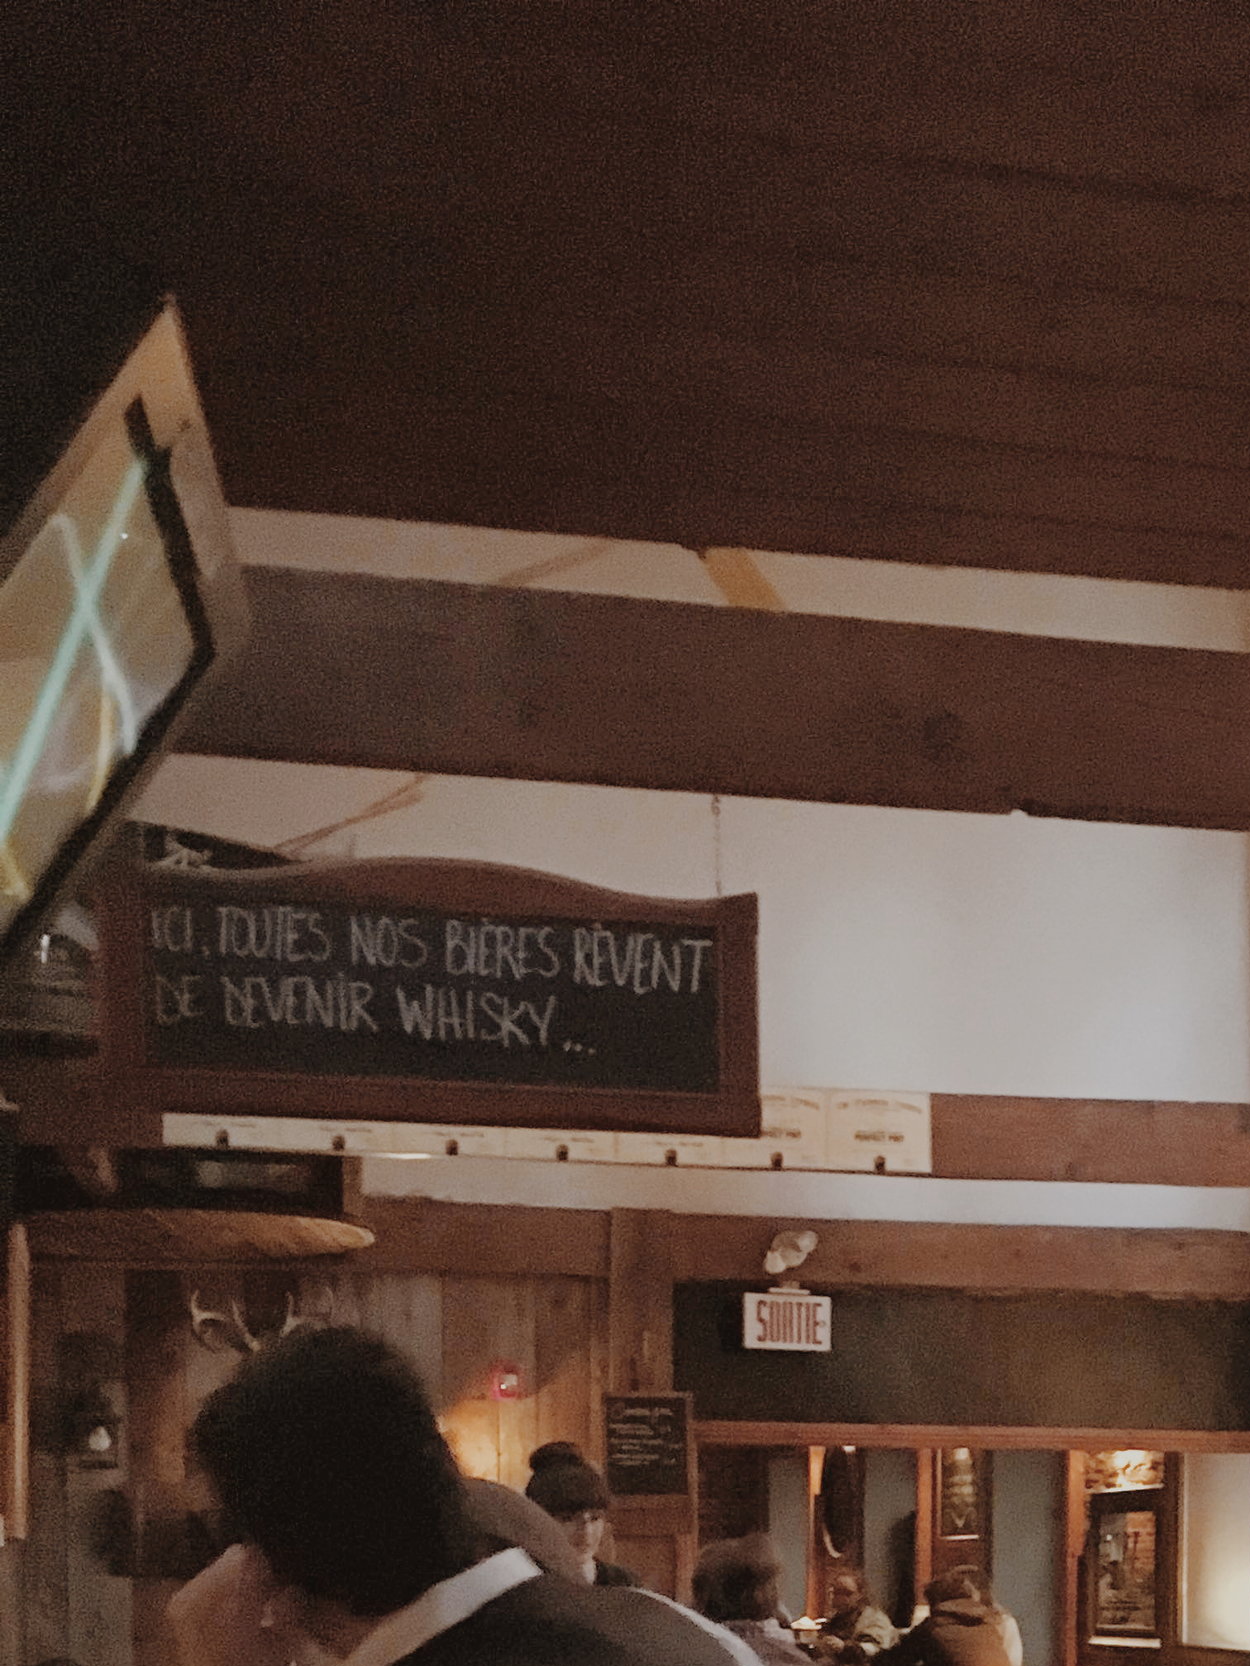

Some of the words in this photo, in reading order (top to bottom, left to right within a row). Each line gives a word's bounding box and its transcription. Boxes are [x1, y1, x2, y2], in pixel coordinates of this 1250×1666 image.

[216, 905, 333, 961] TOUTES
[350, 914, 427, 967] NOS
[155, 974, 203, 1025] DE
[219, 972, 379, 1032] DEVENIR
[756, 1300, 822, 1345] SORTIE
